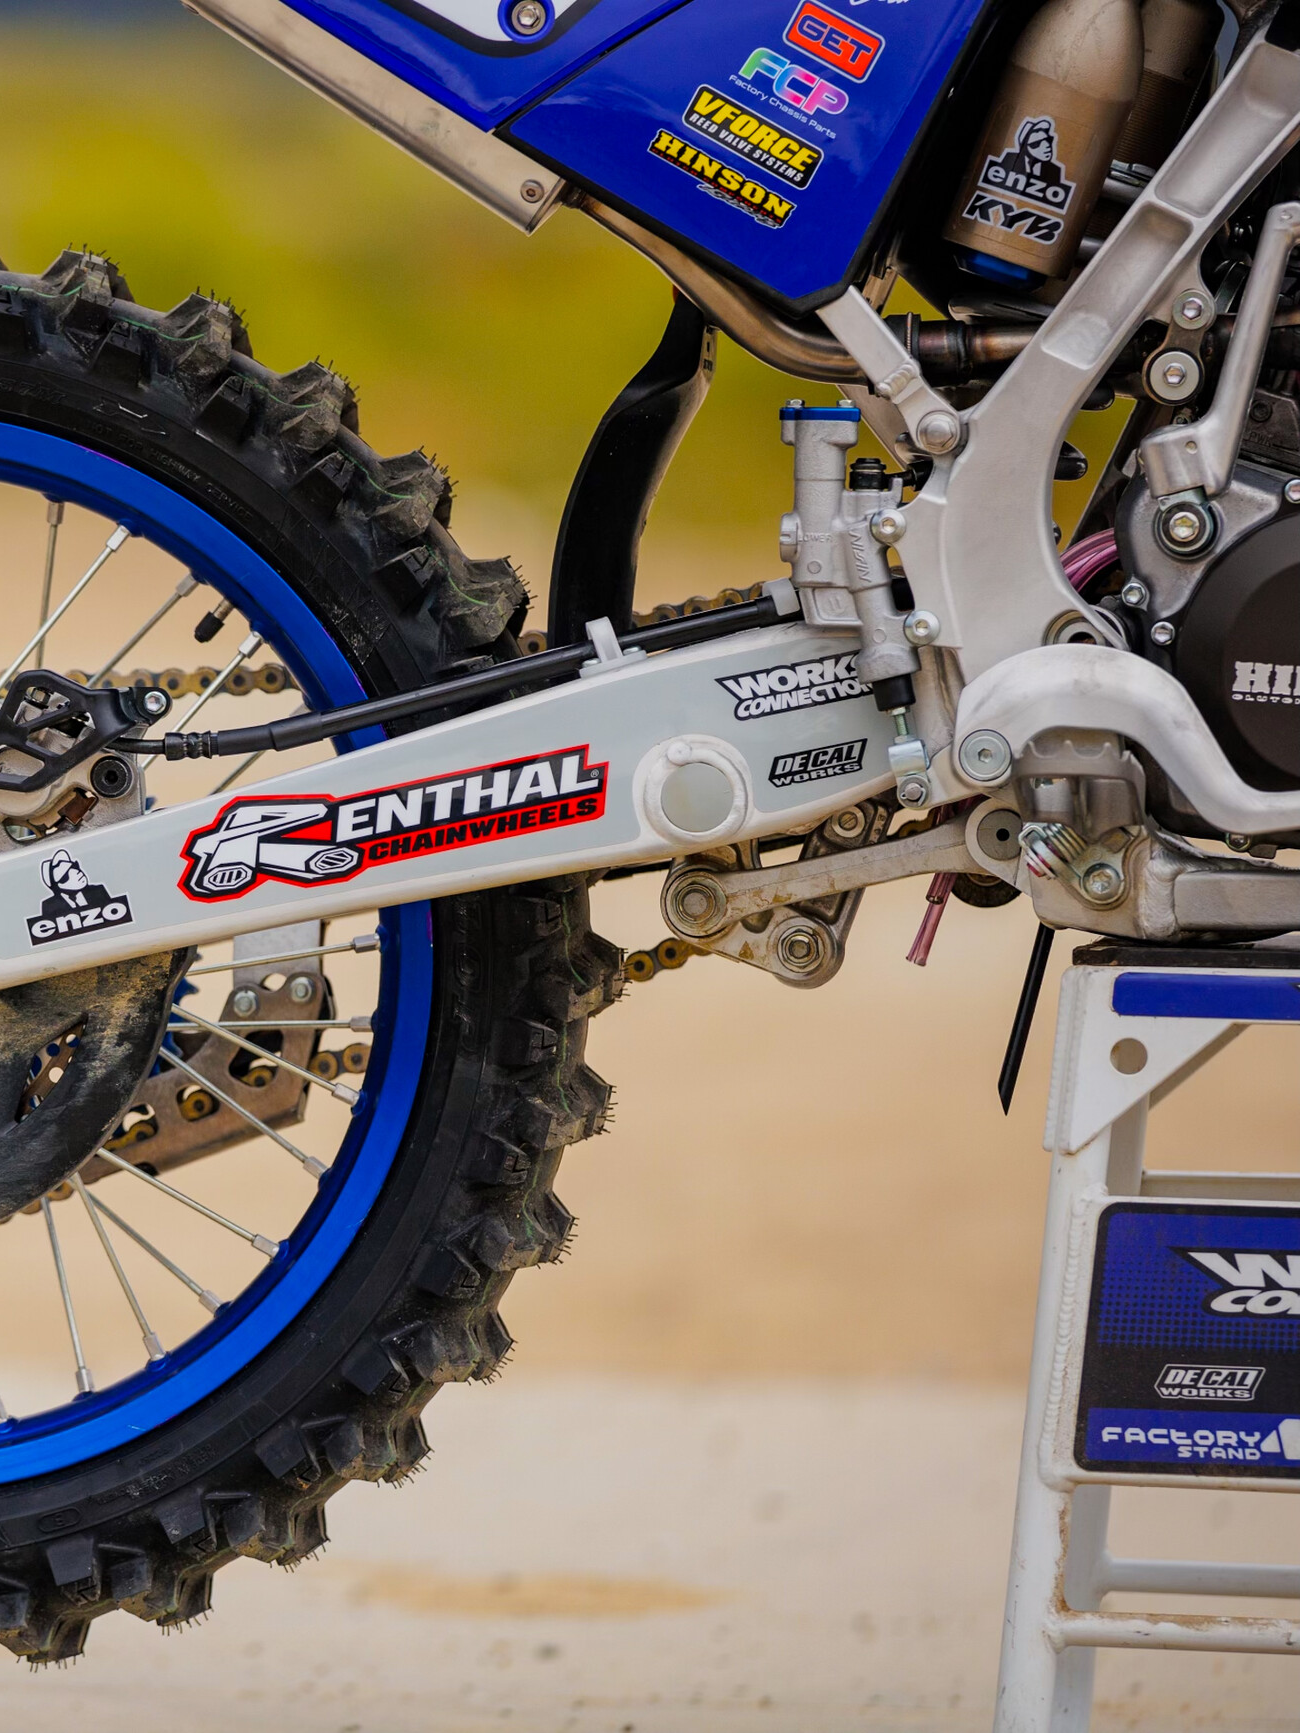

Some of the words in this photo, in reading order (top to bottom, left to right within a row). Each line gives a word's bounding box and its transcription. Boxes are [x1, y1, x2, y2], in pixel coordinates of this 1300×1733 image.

[797, 14, 871, 64] GET
[738, 47, 849, 115] FCP
[729, 75, 768, 100] Factory
[769, 97, 808, 123] Chassis
[808, 119, 836, 139] Parts
[689, 113, 718, 133] REED
[719, 128, 753, 153] VALVE
[753, 149, 804, 182] SYSTEMS
[693, 91, 818, 171] VFORCE
[654, 131, 792, 219] HINSON
[987, 165, 1066, 203] enzo
[965, 194, 1062, 242] KYB
[722, 654, 858, 699] WORK
[773, 763, 861, 786] WORKS
[775, 743, 861, 776] DECAL
[192, 755, 599, 893] RENTHAL
[368, 798, 598, 861] CHAINWHEELS
[31, 902, 127, 938] enzo
[1160, 1387, 1251, 1398] WORKS
[1164, 1368, 1252, 1388] DECAL
[1102, 1427, 1261, 1447] FACTORY
[1178, 1446, 1261, 1460] STAND
